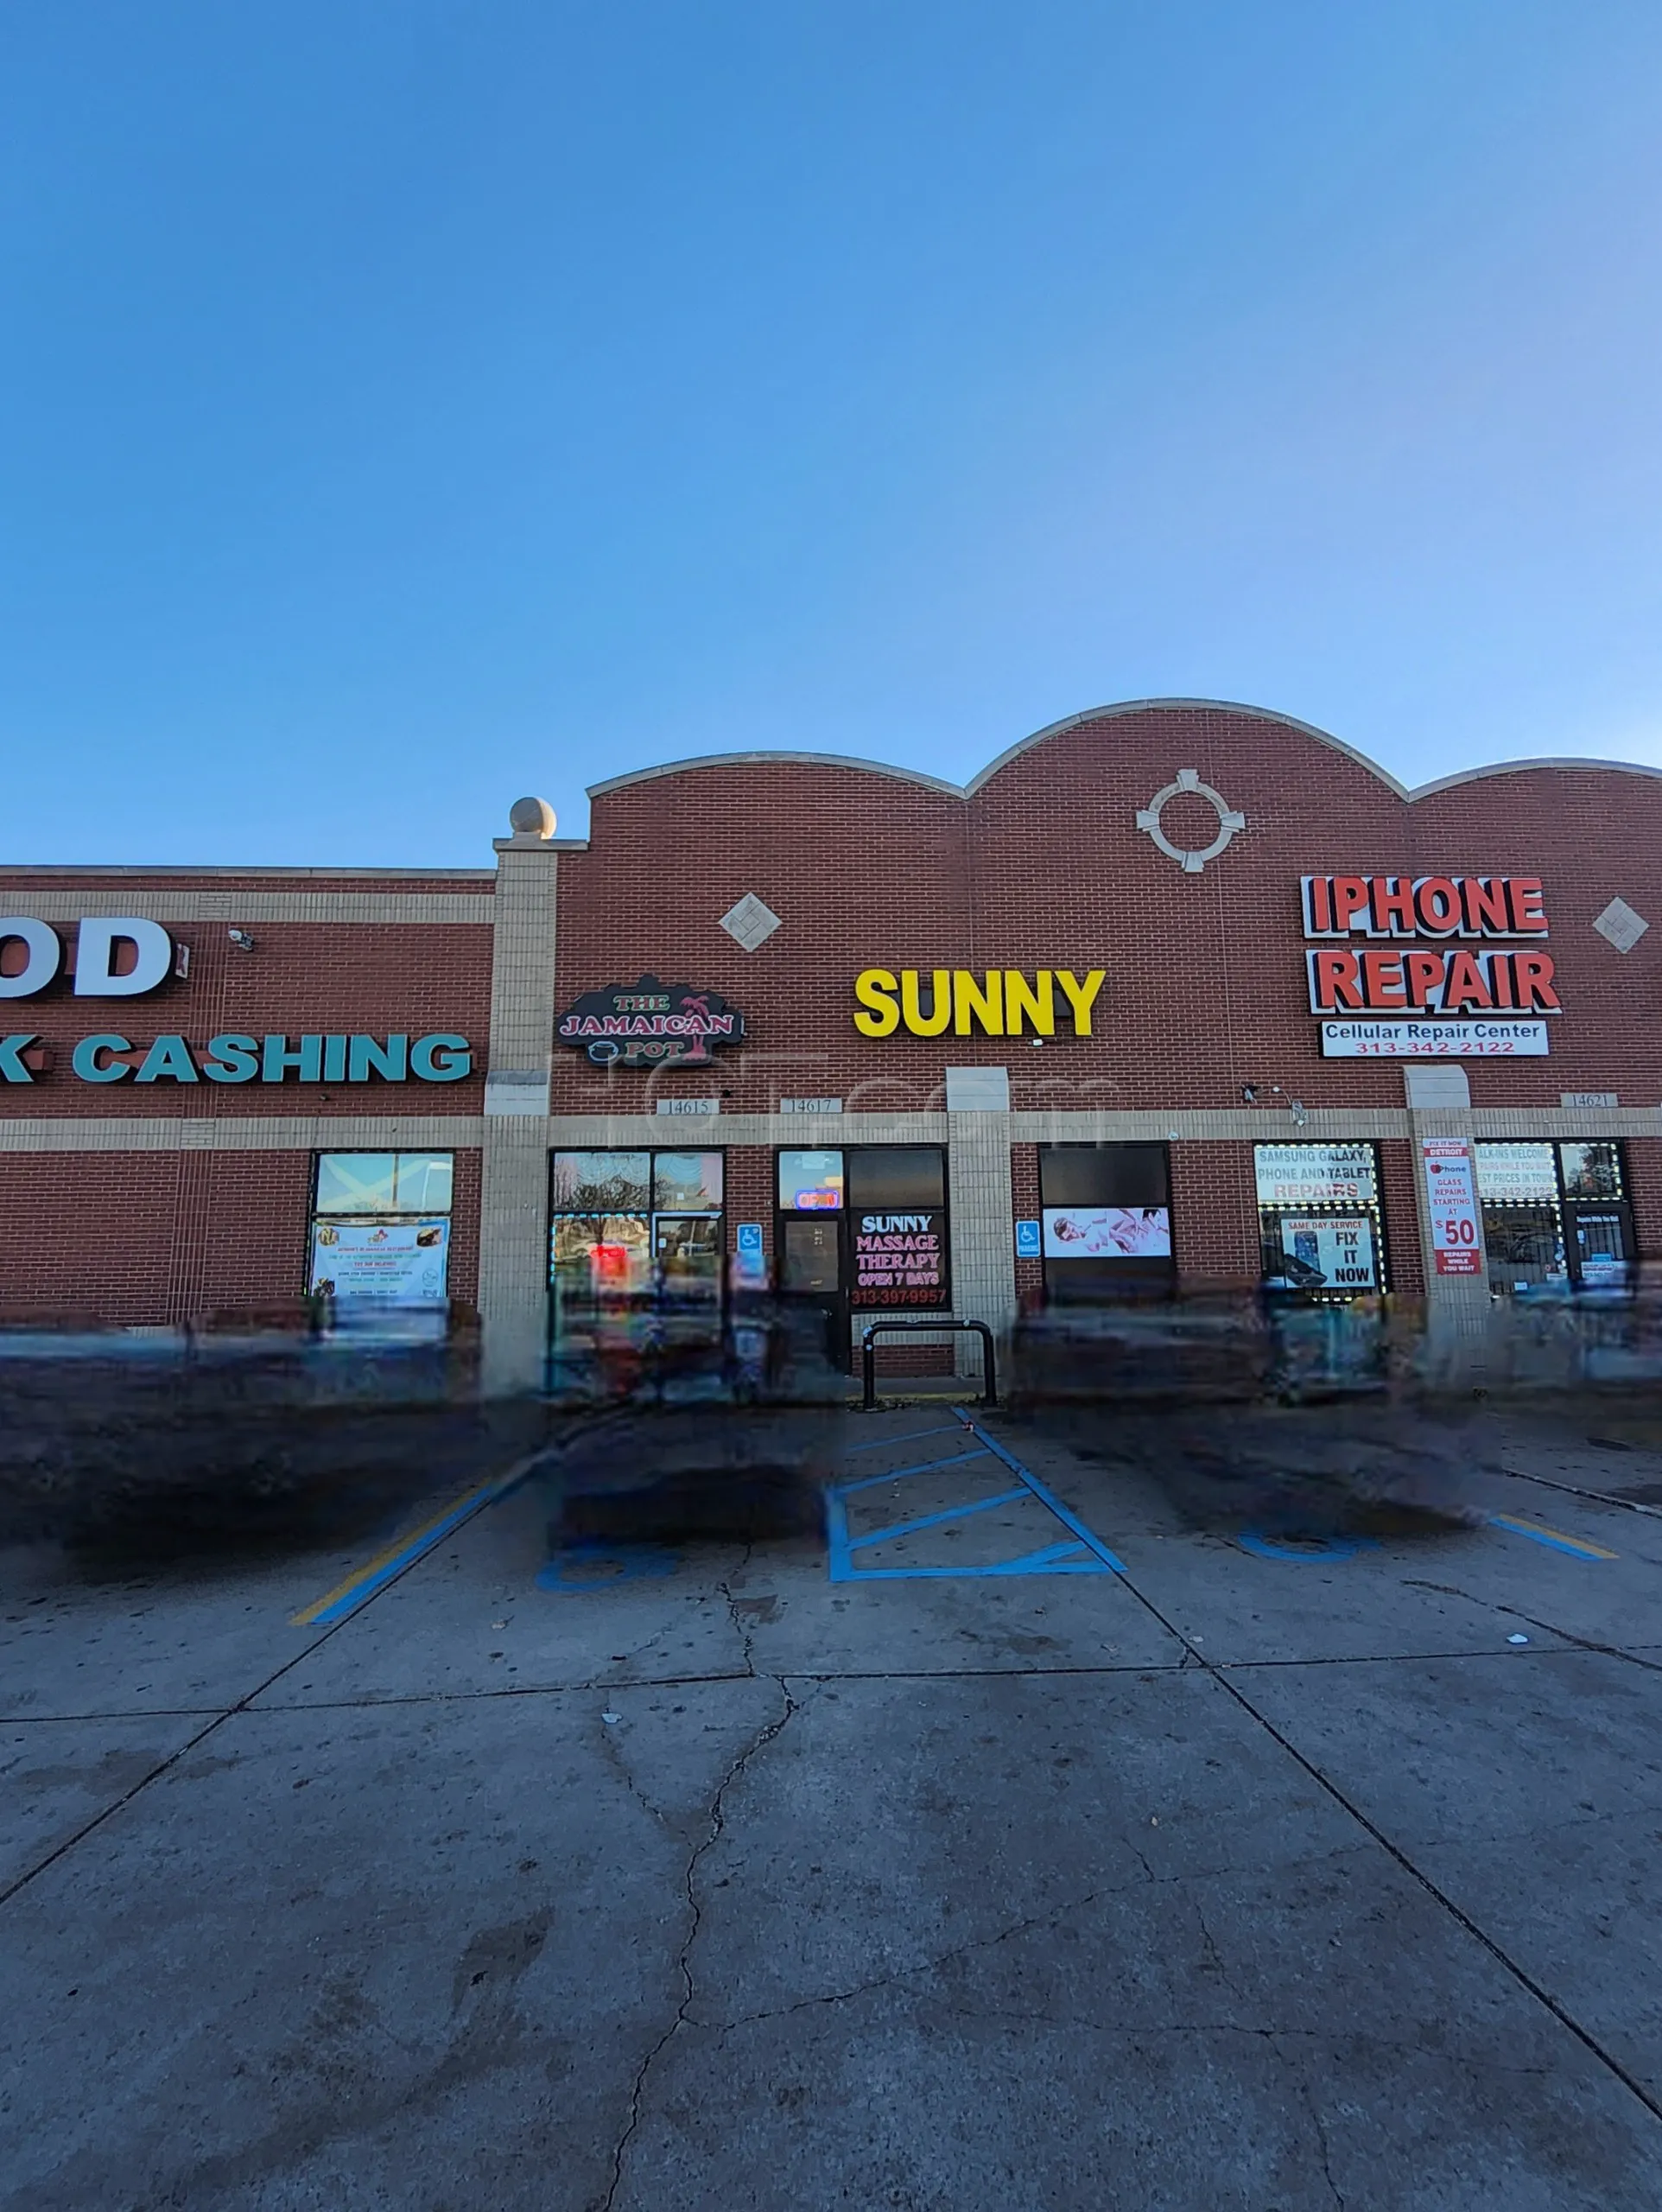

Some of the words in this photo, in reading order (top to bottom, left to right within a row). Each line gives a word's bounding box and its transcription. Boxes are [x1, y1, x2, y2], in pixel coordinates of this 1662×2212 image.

[1301, 876, 1549, 938] IPHONE
[1305, 950, 1563, 1014] REPAIR
[612, 995, 670, 1012] THE
[853, 969, 1107, 1037] SUNNY
[560, 1015, 734, 1036] JAMAICAN
[1325, 1024, 1401, 1039] Cellular
[1407, 1024, 1469, 1041] Repair
[1474, 1023, 1540, 1038] Center
[625, 1041, 685, 1058] POT
[1355, 1042, 1515, 1054] 313-342-2122
[73, 1033, 471, 1083] CASHING
[668, 1100, 709, 1114] 14615
[790, 1099, 832, 1113] 14617
[1572, 1094, 1608, 1106] 14621
[1259, 1149, 1316, 1163] SAMSUNG
[1479, 1148, 1508, 1159] ALK-INS
[1258, 1167, 1297, 1180] PHONE
[1301, 1167, 1325, 1180] AND
[1327, 1166, 1371, 1179] TABLET
[1478, 1173, 1491, 1183] EST
[1273, 1182, 1359, 1198] REPAIRS
[861, 1215, 933, 1233] SUNNY
[1312, 1221, 1328, 1230] DAY
[1330, 1220, 1363, 1229] SERVICE
[856, 1235, 940, 1251] MASSAGE
[1335, 1231, 1359, 1246] FIX
[855, 1252, 941, 1270] THERAPY
[1344, 1249, 1357, 1264] IT
[857, 1272, 893, 1287] OPEN
[894, 1272, 904, 1286] 7
[905, 1271, 940, 1286] DAYS
[1335, 1268, 1369, 1282] NOW
